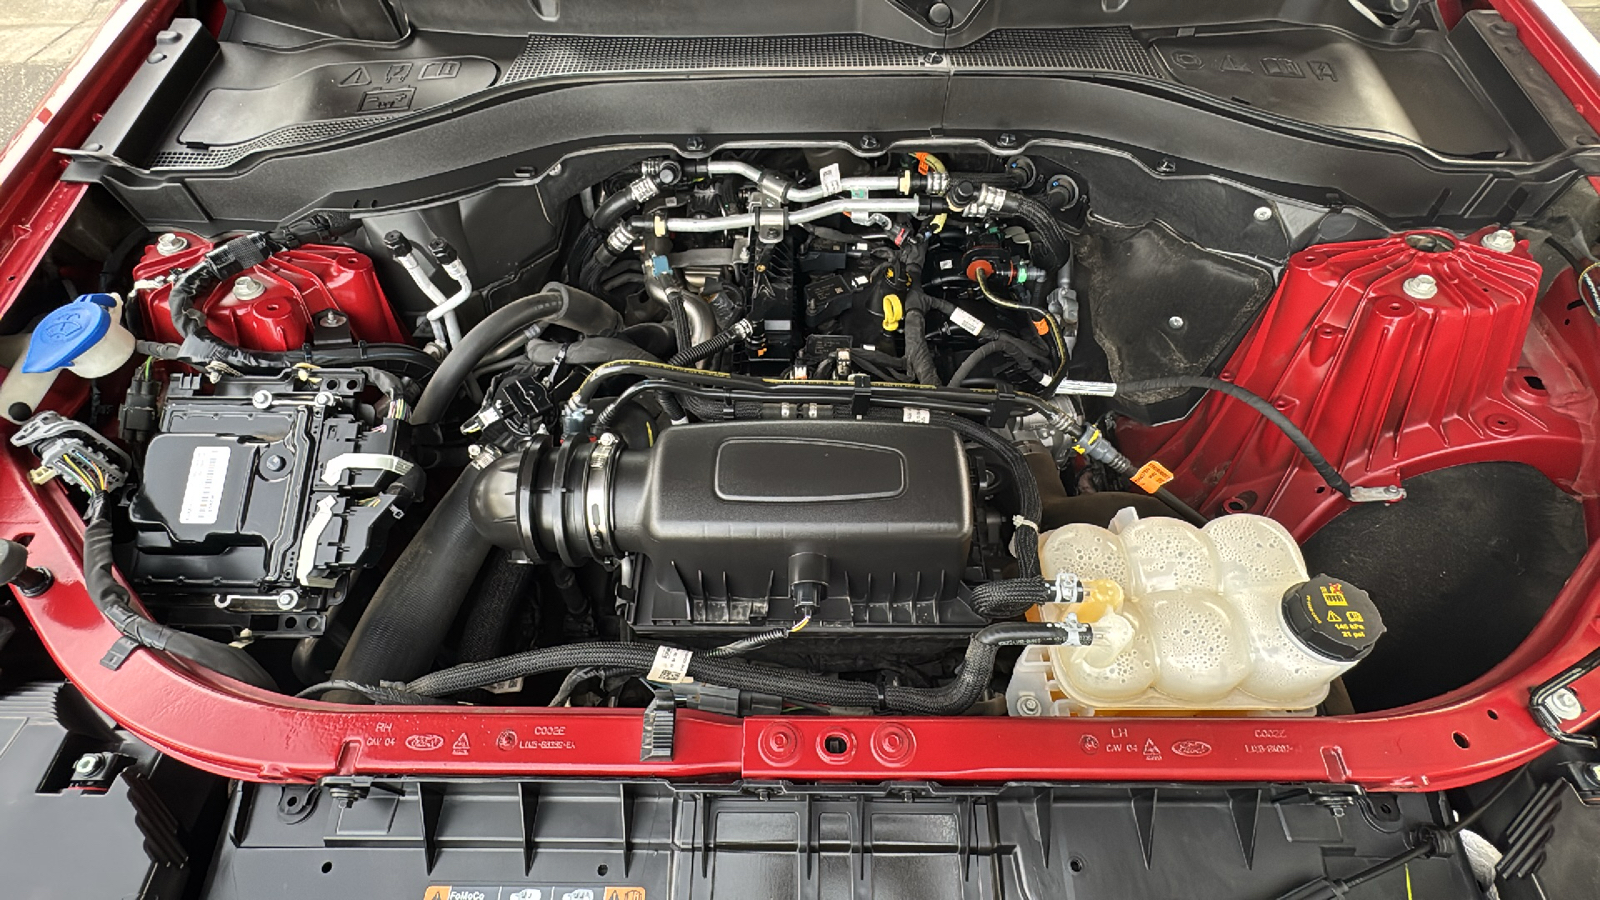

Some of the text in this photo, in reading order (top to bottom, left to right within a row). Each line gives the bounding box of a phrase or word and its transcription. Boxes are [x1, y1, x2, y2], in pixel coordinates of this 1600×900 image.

[375, 722, 392, 732] RH
[1110, 728, 1128, 738] LH
[450, 891, 485, 900] FoMoCo
